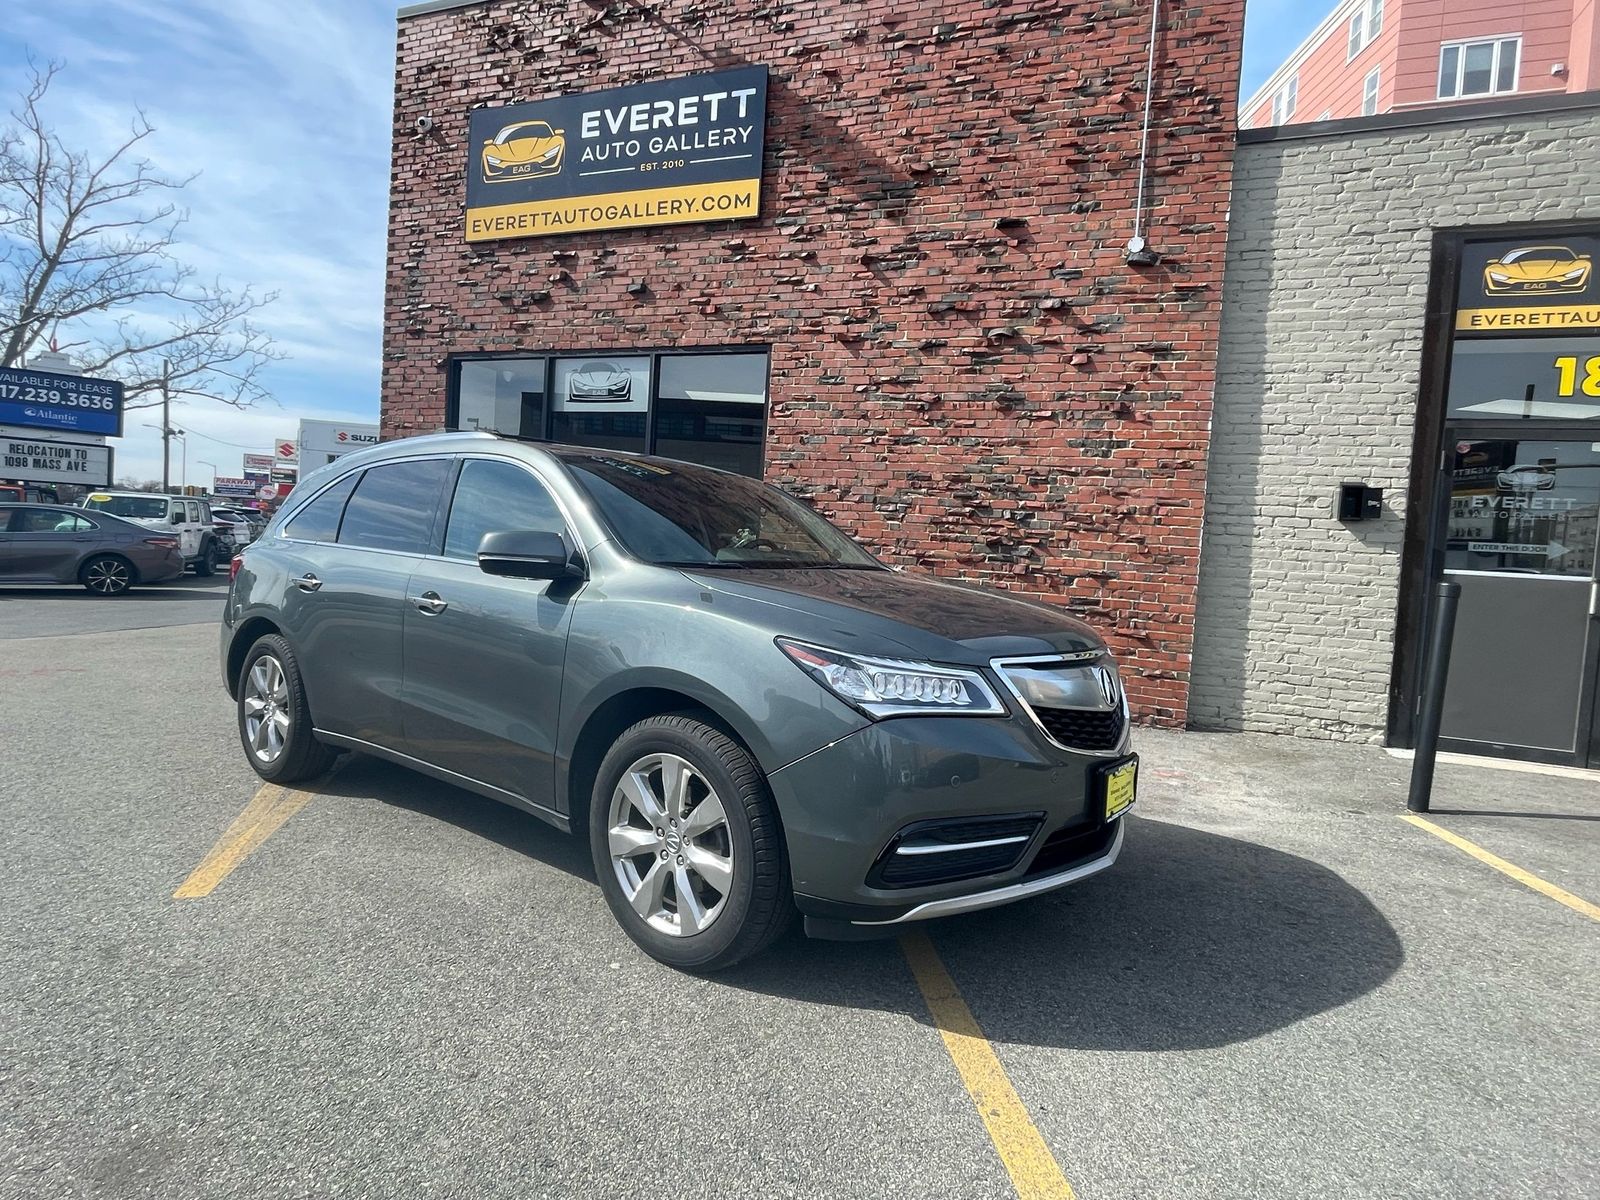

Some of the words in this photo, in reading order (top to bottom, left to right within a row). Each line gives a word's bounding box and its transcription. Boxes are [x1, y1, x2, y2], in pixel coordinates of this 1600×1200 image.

[581, 88, 757, 138] EVERETT
[581, 140, 640, 162] AUTO
[649, 125, 753, 154] GALLERY
[512, 164, 531, 174] EAG
[640, 162, 660, 172] EST.
[663, 159, 684, 169] 2010
[472, 193, 751, 233] EVERETTAUTOGALLERY.COM
[1523, 282, 1547, 290] EAG
[54, 379, 76, 391] FOR
[79, 383, 113, 395] LEASE
[0, 384, 114, 410] 17.239.3636
[36, 409, 78, 421] Atlantic
[9, 443, 72, 459] RELOCATION
[75, 448, 88, 460] TO
[4, 456, 28, 468] 1098
[32, 458, 62, 470] MASS
[66, 460, 88, 472] AVE
[215, 477, 254, 485] PARKWAY
[1472, 496, 1577, 510] EVERETT
[1472, 510, 1509, 519] AUTO
[1473, 543, 1499, 551] ENTER
[1501, 544, 1520, 552] THIS
